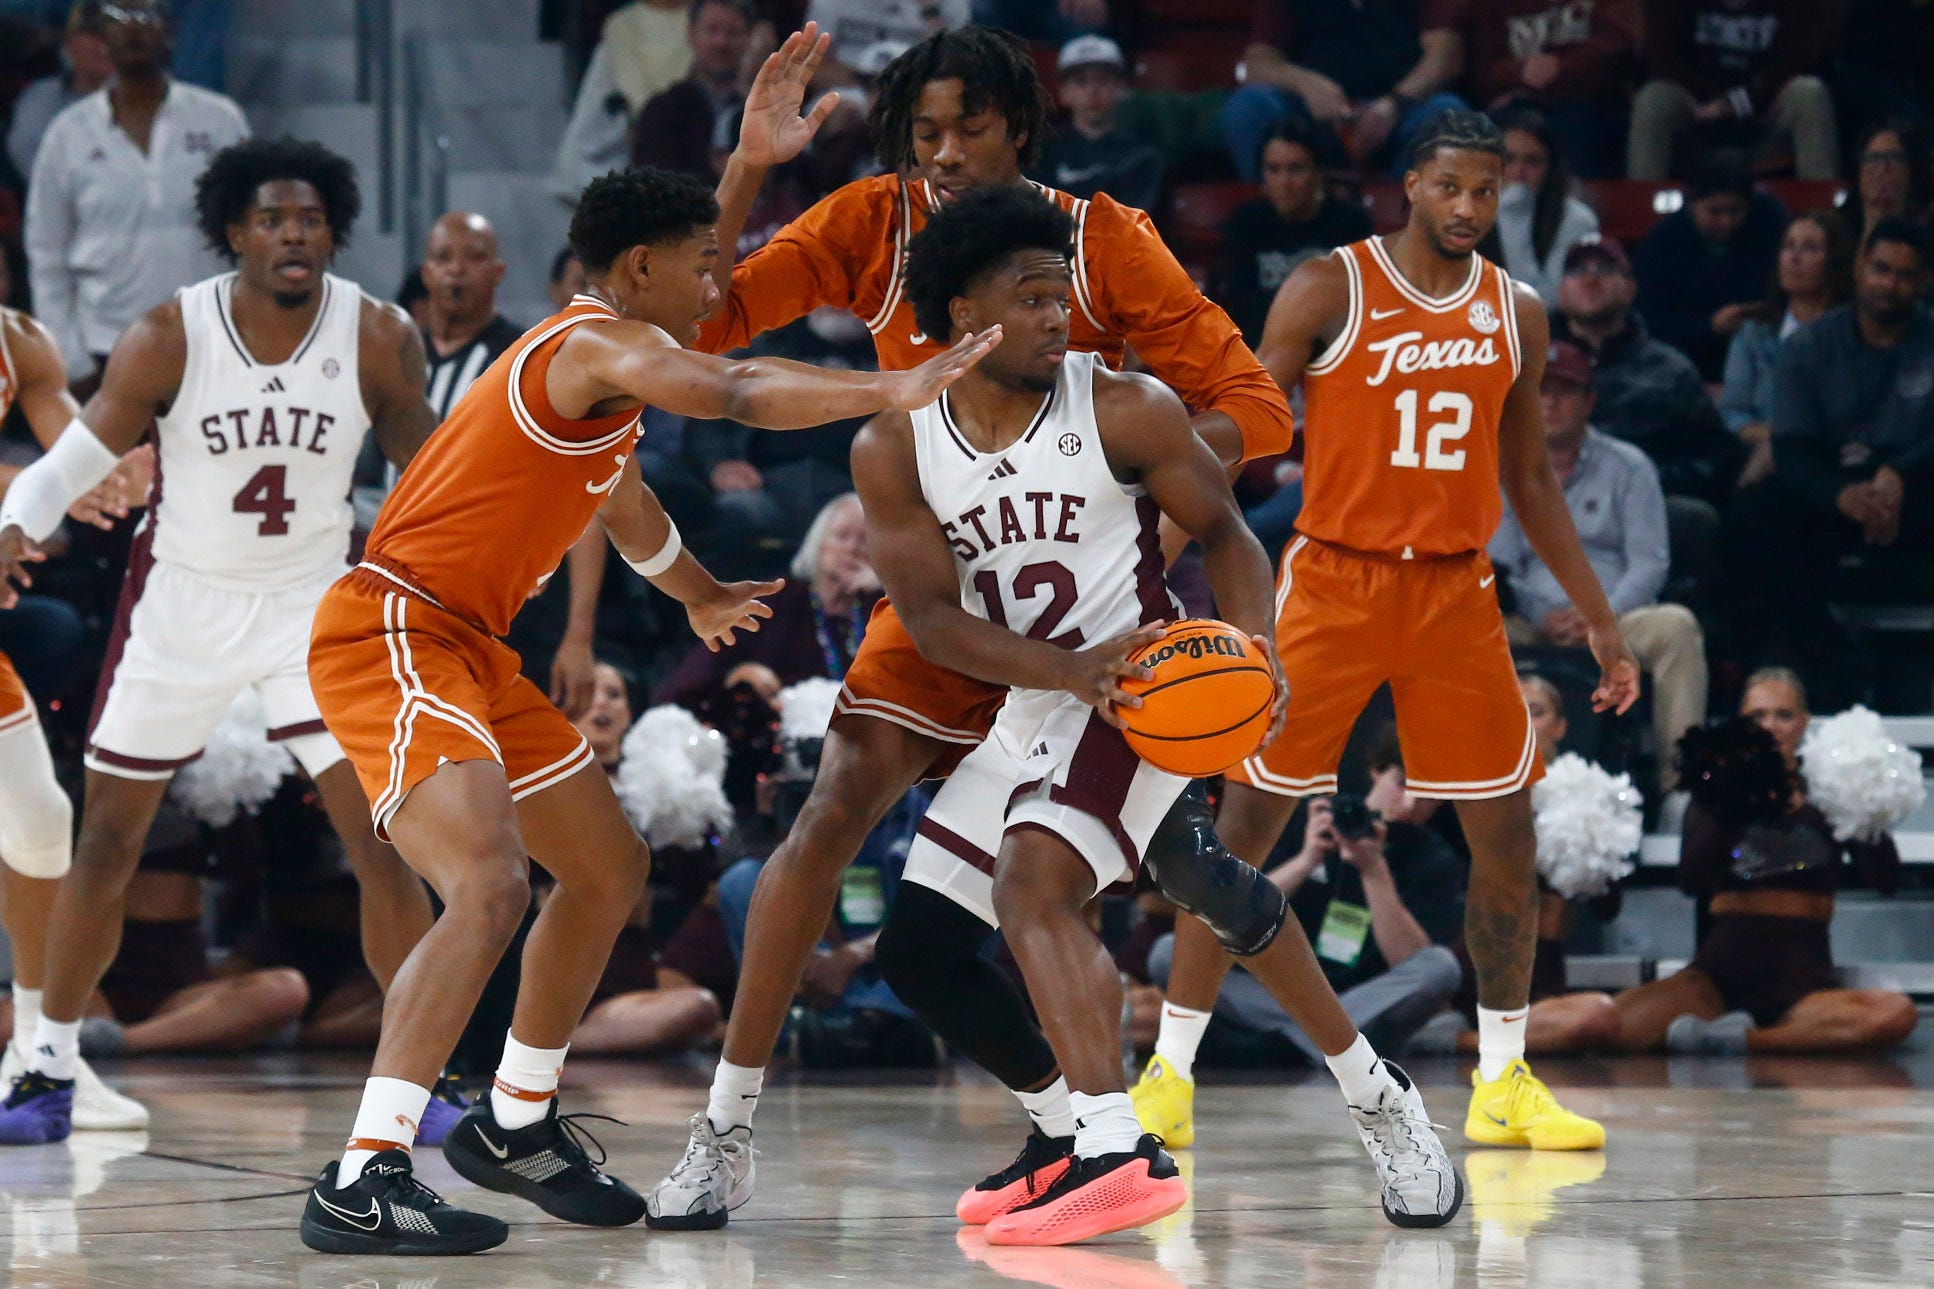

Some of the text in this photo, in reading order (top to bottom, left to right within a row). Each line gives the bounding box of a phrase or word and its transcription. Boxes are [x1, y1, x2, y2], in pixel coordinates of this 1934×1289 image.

[1366, 331, 1499, 387] Texas
[200, 406, 336, 455] STATE
[1058, 433, 1082, 457] SEC
[1390, 389, 1473, 471] 12
[232, 464, 296, 536] 4
[942, 491, 1086, 562] STATE
[973, 560, 1087, 650] 12
[1138, 635, 1246, 669] Wilson
